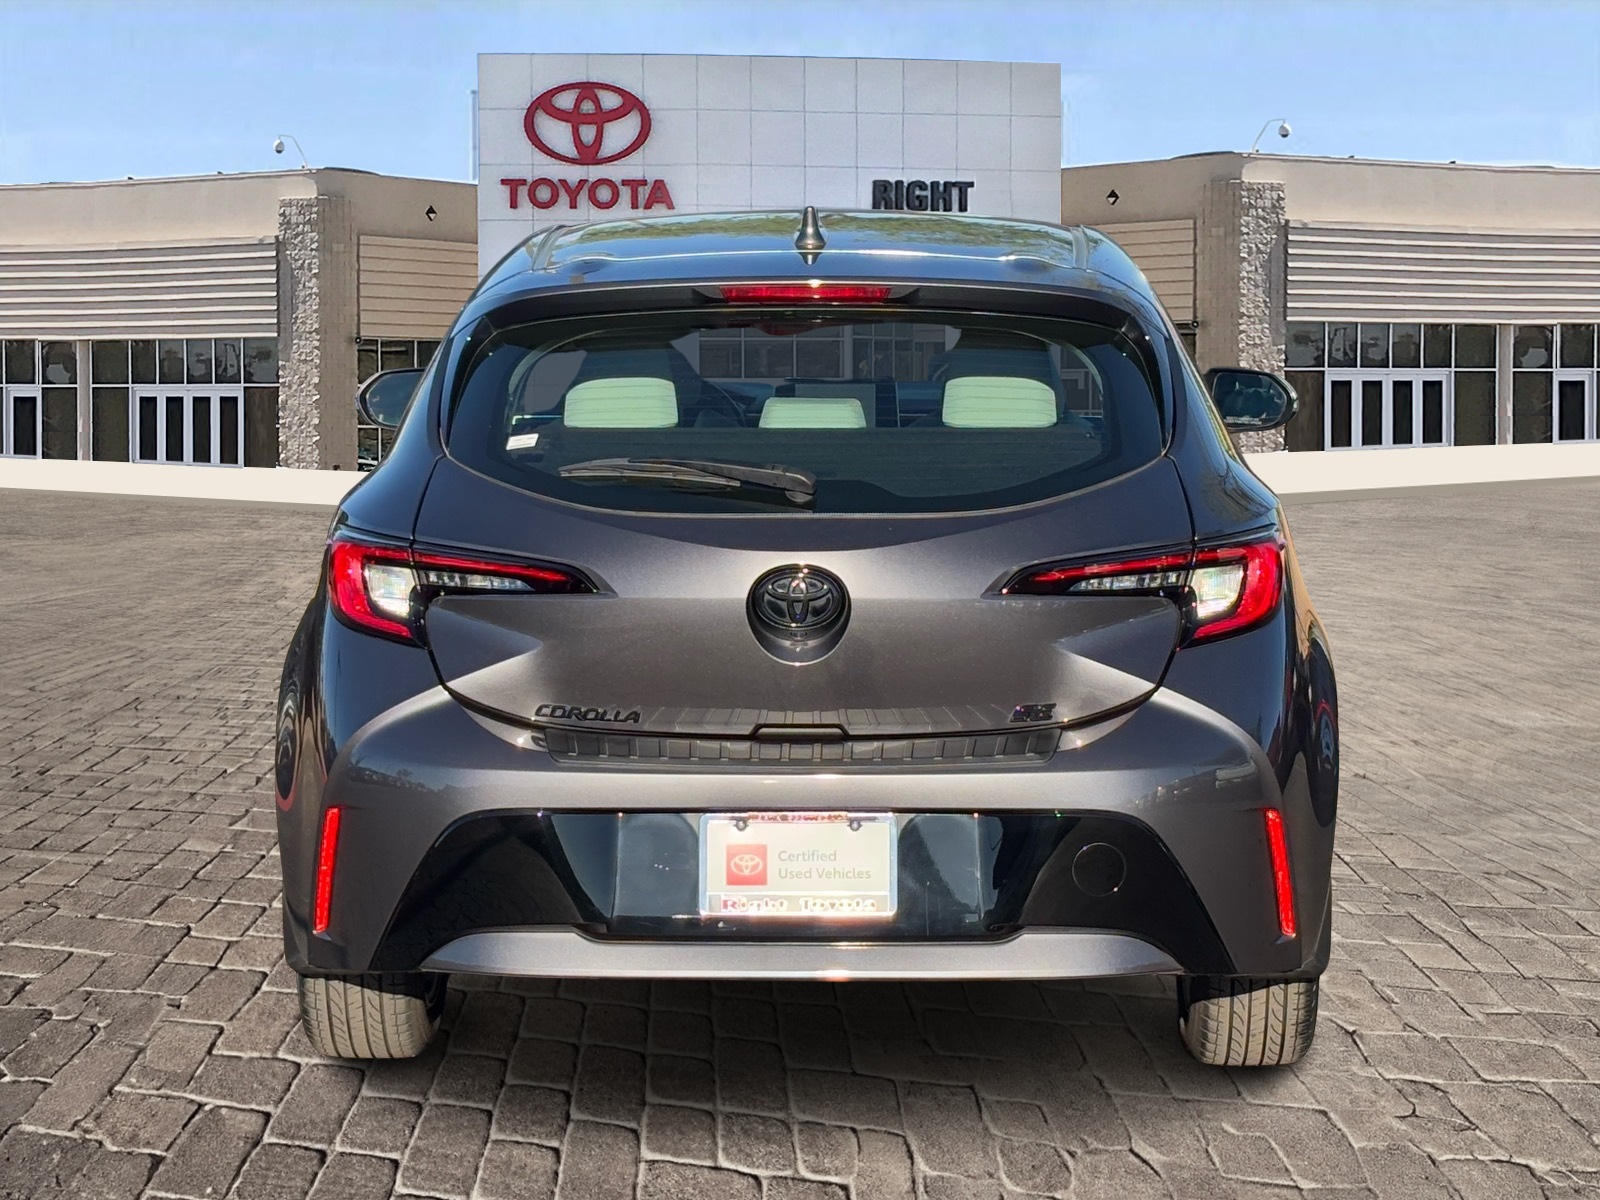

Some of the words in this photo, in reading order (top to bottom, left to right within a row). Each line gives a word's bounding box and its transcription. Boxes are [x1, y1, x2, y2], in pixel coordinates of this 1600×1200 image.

[501, 178, 675, 210] TOYOTA
[872, 179, 974, 212] RIGHT
[534, 704, 642, 723] COROLLA
[778, 850, 837, 862] Certified
[778, 868, 812, 879] Used
[817, 867, 871, 879] Vehicles
